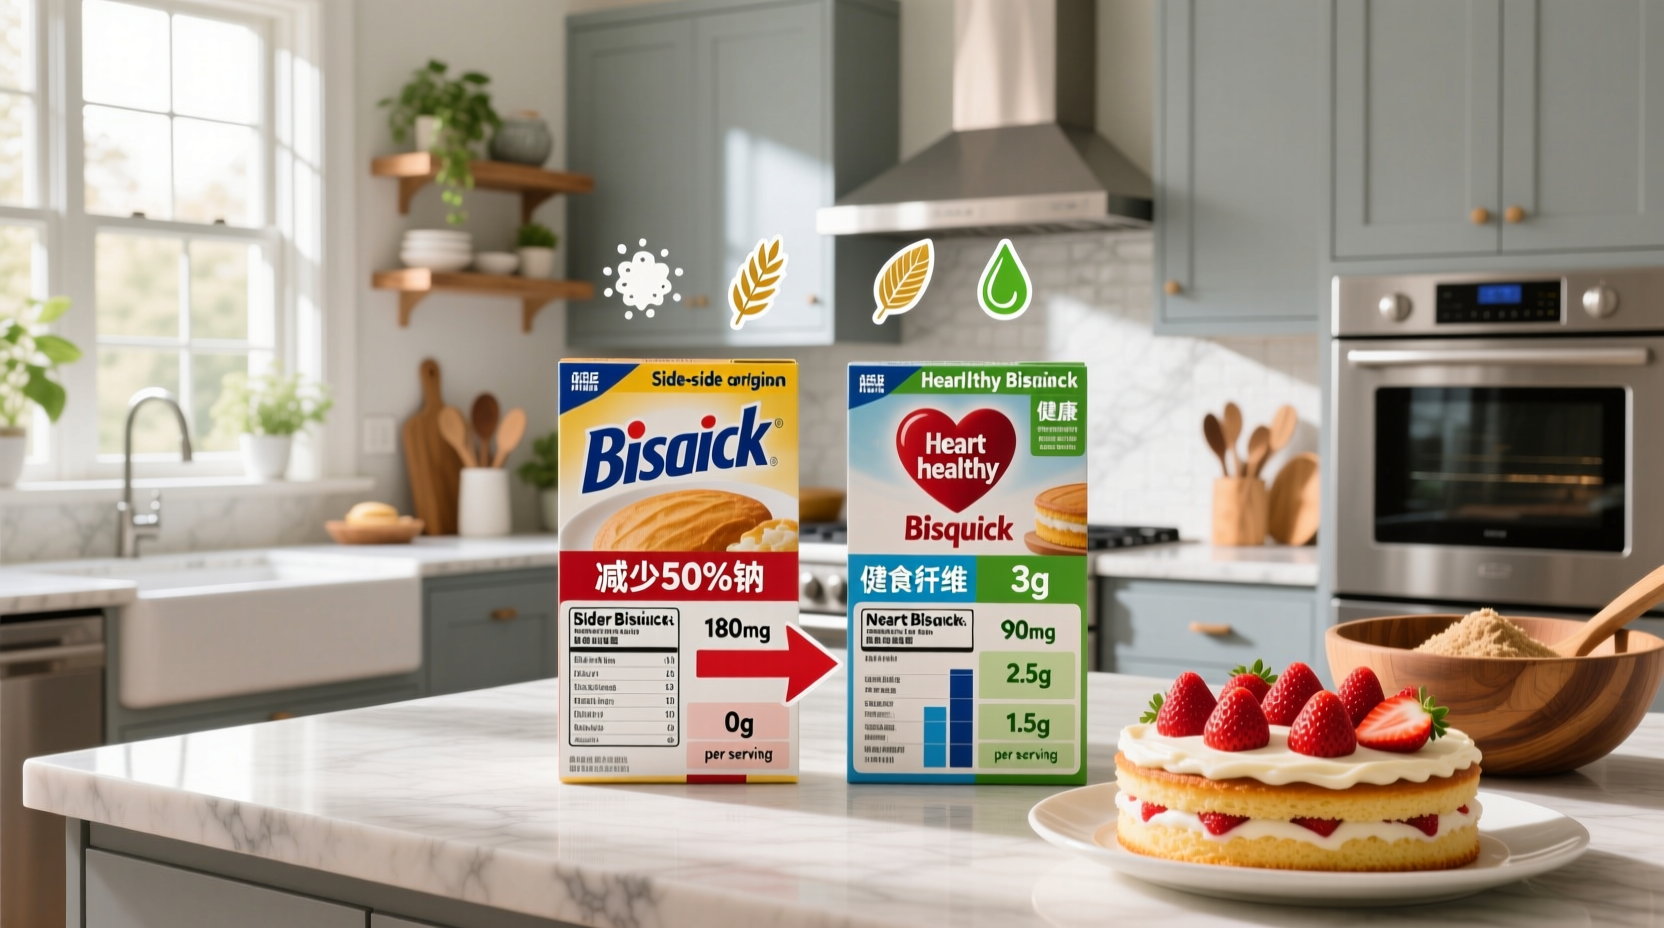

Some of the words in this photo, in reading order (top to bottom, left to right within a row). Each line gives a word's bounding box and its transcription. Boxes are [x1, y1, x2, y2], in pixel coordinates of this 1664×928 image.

[652, 371, 723, 387] Side-side
[1037, 400, 1078, 422] 健康
[926, 432, 986, 454] Heart
[917, 456, 999, 484] healthy
[905, 514, 1013, 548] Bisquick
[595, 560, 764, 593] 减少50%钠
[860, 565, 967, 594] 健食纤维
[1011, 565, 1049, 600] 3g
[705, 617, 771, 644] 180mg
[1001, 619, 1056, 644] 90mg
[1006, 663, 1051, 689] 2.5g
[725, 711, 754, 738] 0g
[1006, 712, 1050, 739] 1.5g
[705, 750, 725, 764] per
[728, 747, 773, 763] serving
[995, 751, 1013, 763] per
